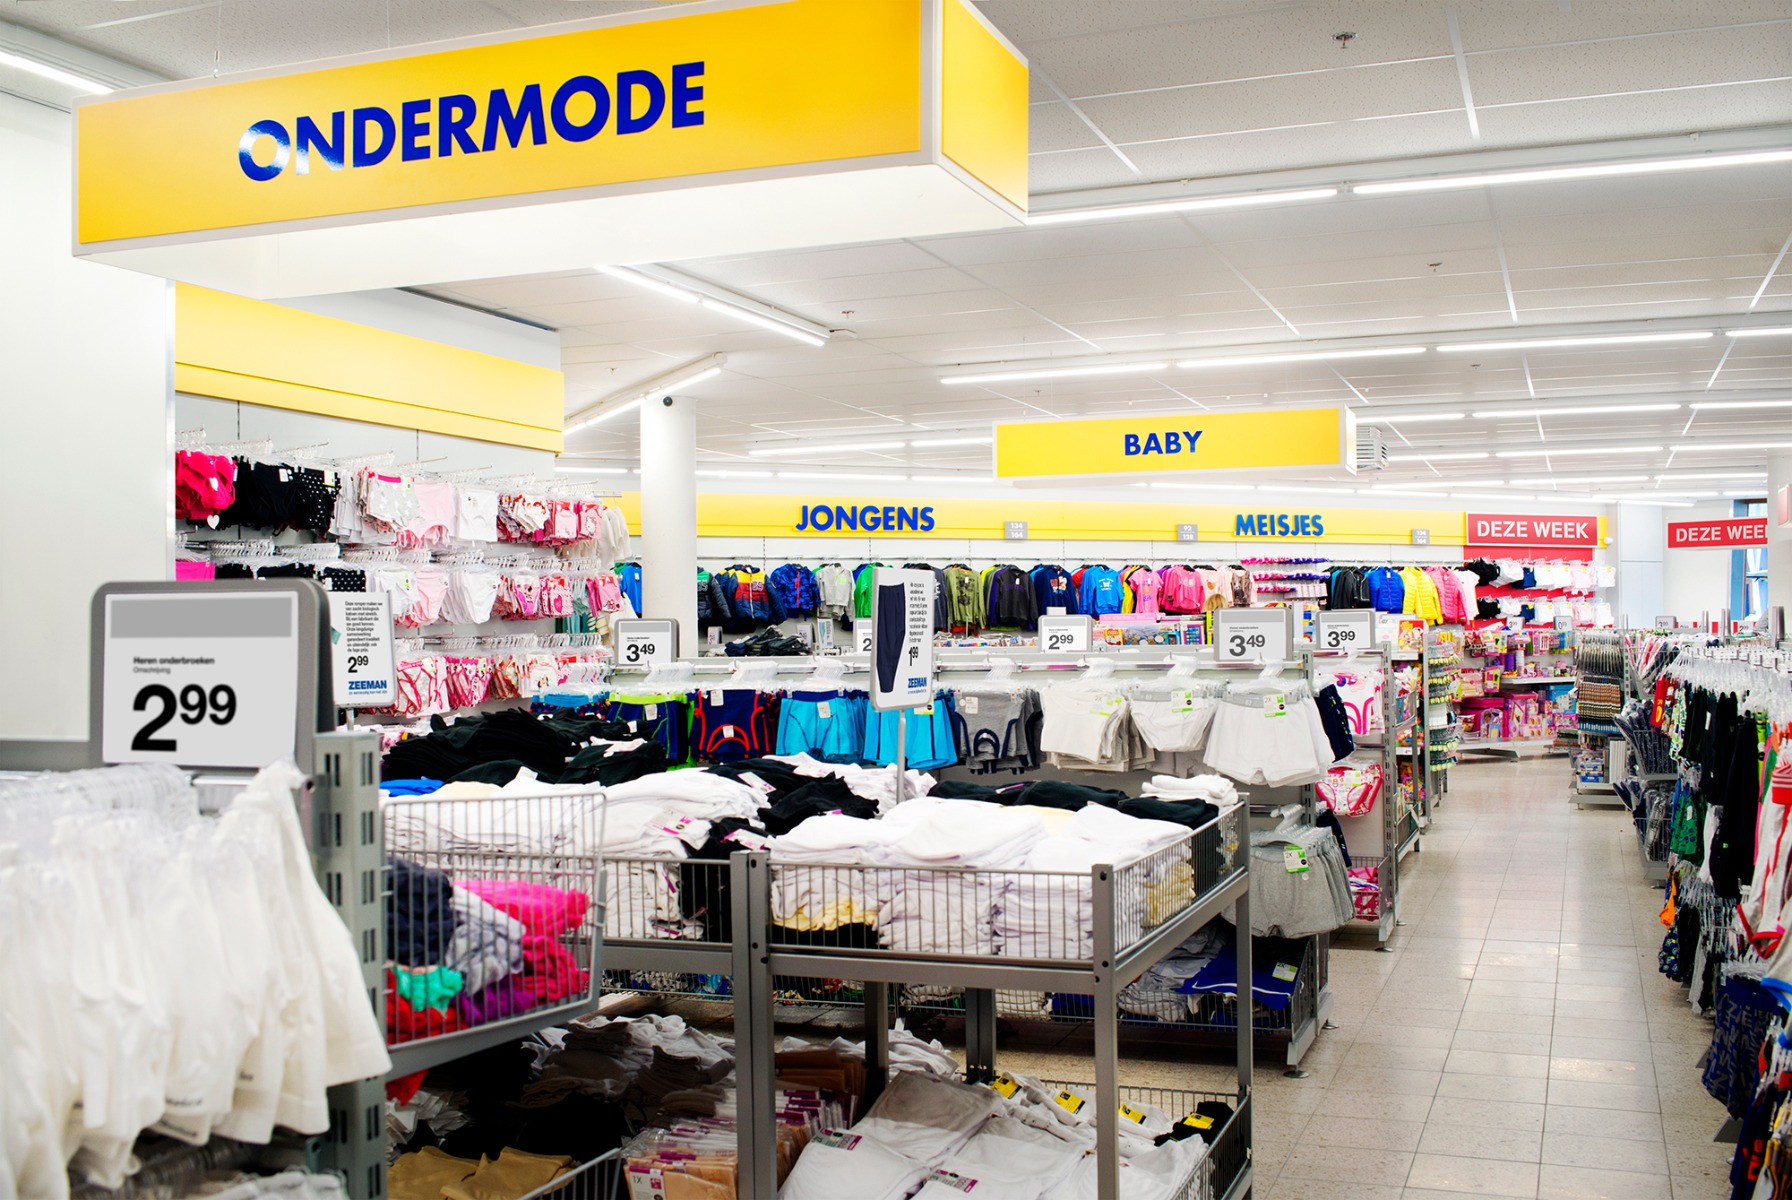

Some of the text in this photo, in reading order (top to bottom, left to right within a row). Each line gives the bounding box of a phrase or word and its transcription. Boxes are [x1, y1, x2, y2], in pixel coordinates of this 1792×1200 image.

[238, 61, 706, 182] ONDERMODE
[1124, 430, 1203, 456] BABY
[796, 504, 935, 532] JONGENS
[1235, 514, 1324, 537] MEISJES
[1476, 521, 1589, 539] DEZE WEEK
[1675, 526, 1721, 543] DEZE
[1048, 634, 1074, 650] 299
[1229, 634, 1265, 657] 349
[1327, 630, 1356, 648] 399
[133, 656, 215, 664] Heren onderbroeken
[626, 643, 656, 662] 349
[908, 646, 919, 666] 199
[348, 655, 369, 673] 299
[348, 680, 387, 690] ZEEMAN
[908, 676, 927, 689] ZEEMAN
[131, 683, 237, 752] 299
